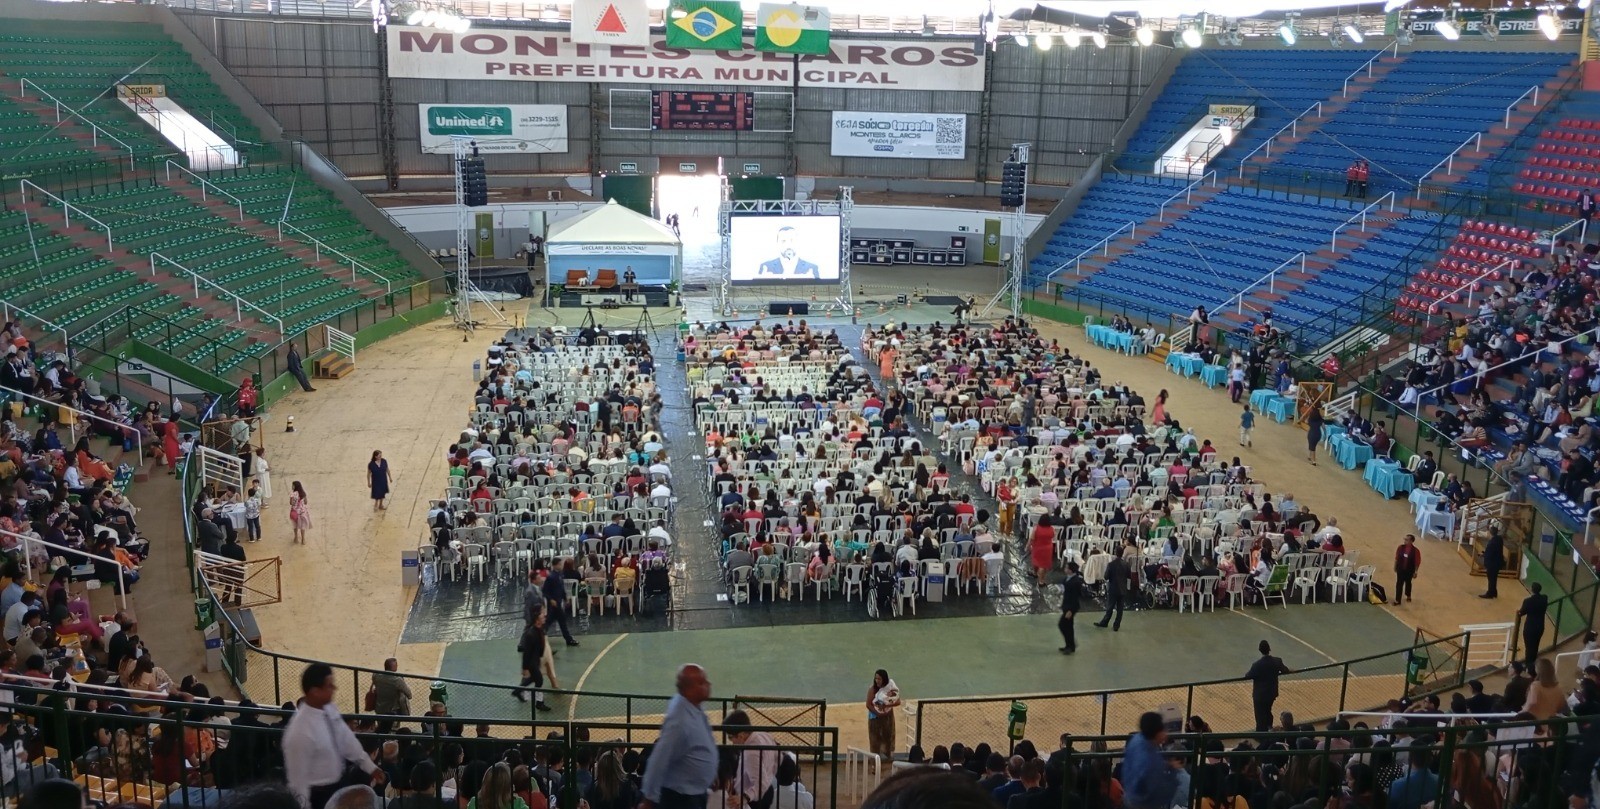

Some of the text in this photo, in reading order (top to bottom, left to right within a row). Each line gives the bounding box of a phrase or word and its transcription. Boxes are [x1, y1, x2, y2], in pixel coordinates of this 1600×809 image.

[485, 62, 899, 85] PREFEITURA MUNCIPAL
[435, 115, 487, 127] Unimed
[835, 119, 858, 129] SEJA
[892, 119, 934, 131] torcedor
